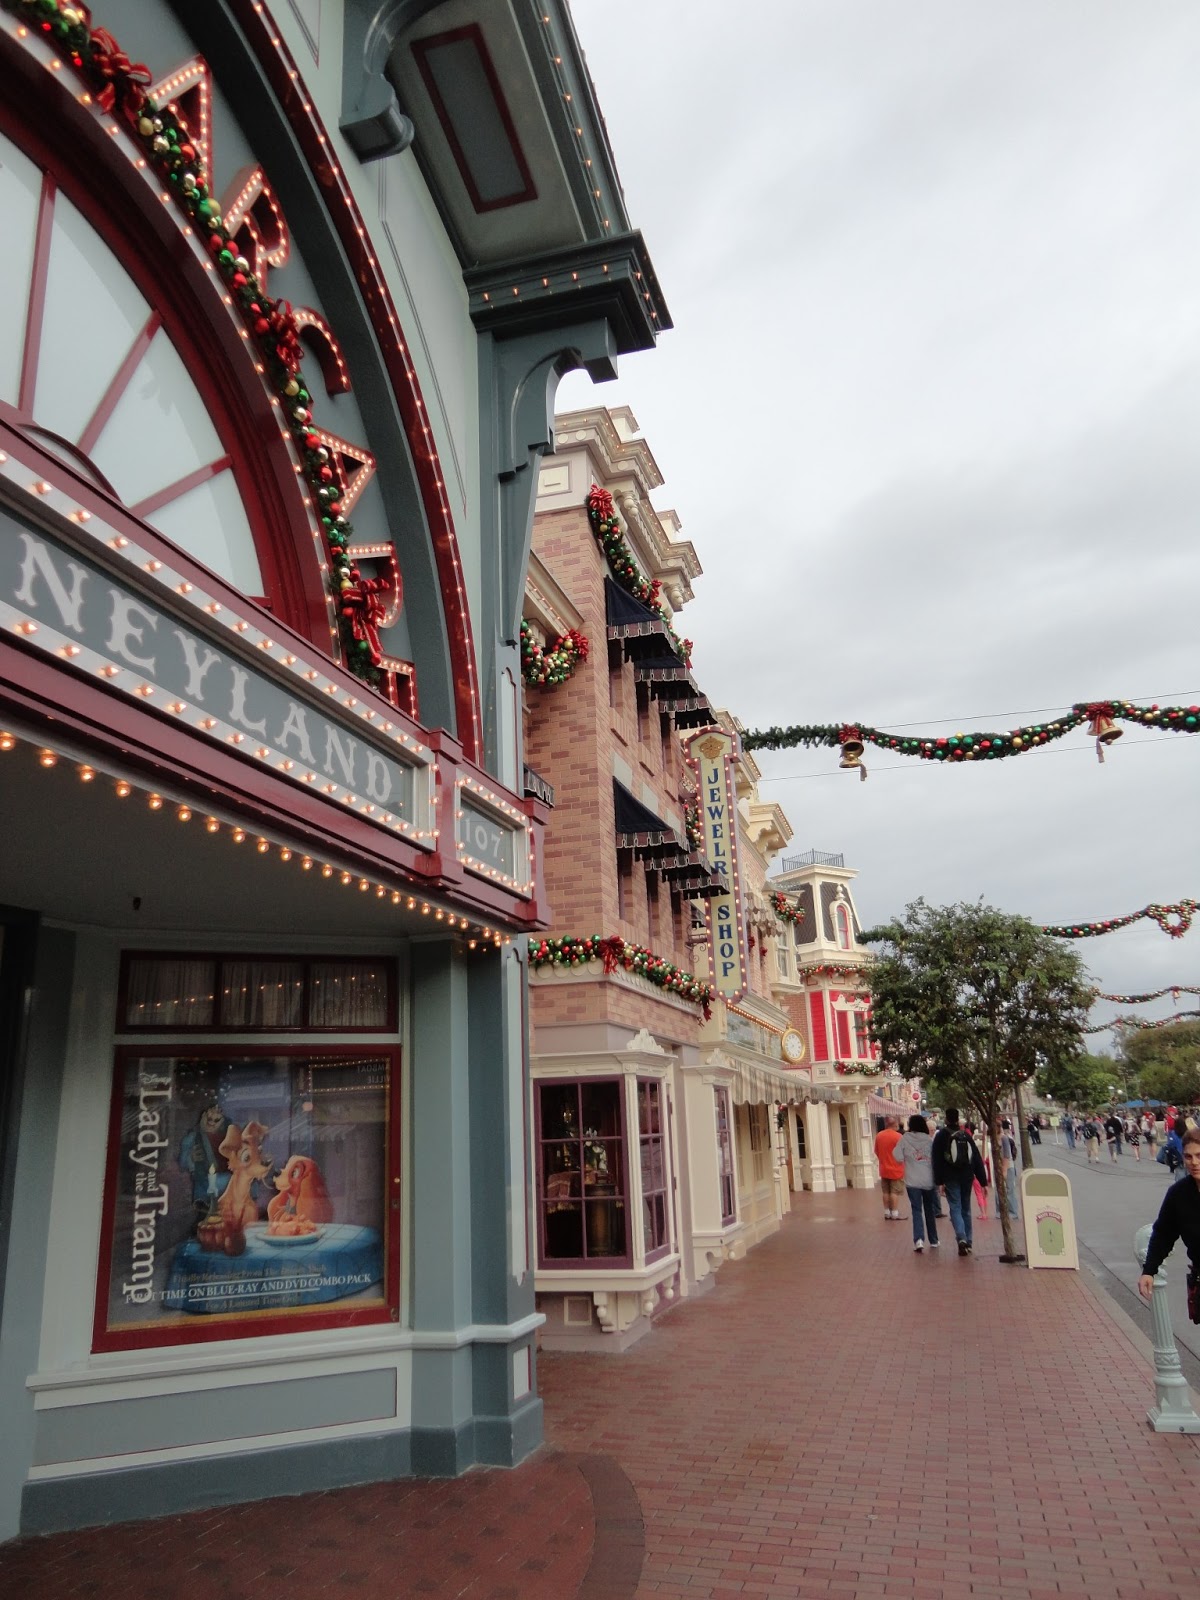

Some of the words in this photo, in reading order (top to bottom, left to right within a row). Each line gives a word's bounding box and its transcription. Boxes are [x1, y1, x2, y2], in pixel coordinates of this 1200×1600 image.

[14, 533, 392, 804] NEYLAND
[465, 817, 501, 858] 107
[706, 767, 729, 876] JEWELR
[718, 903, 736, 978] SHOP
[128, 1086, 173, 1170] Lady
[135, 1172, 147, 1191] the
[147, 1171, 160, 1192] and
[122, 1183, 169, 1304] Tramp
[159, 1288, 187, 1300] TIME
[188, 1287, 206, 1298] ON
[206, 1282, 259, 1296] BLUE-RAY
[260, 1280, 285, 1292] AND
[284, 1278, 308, 1290] DVD
[308, 1275, 346, 1288] COMBO
[346, 1273, 372, 1284] PACK
